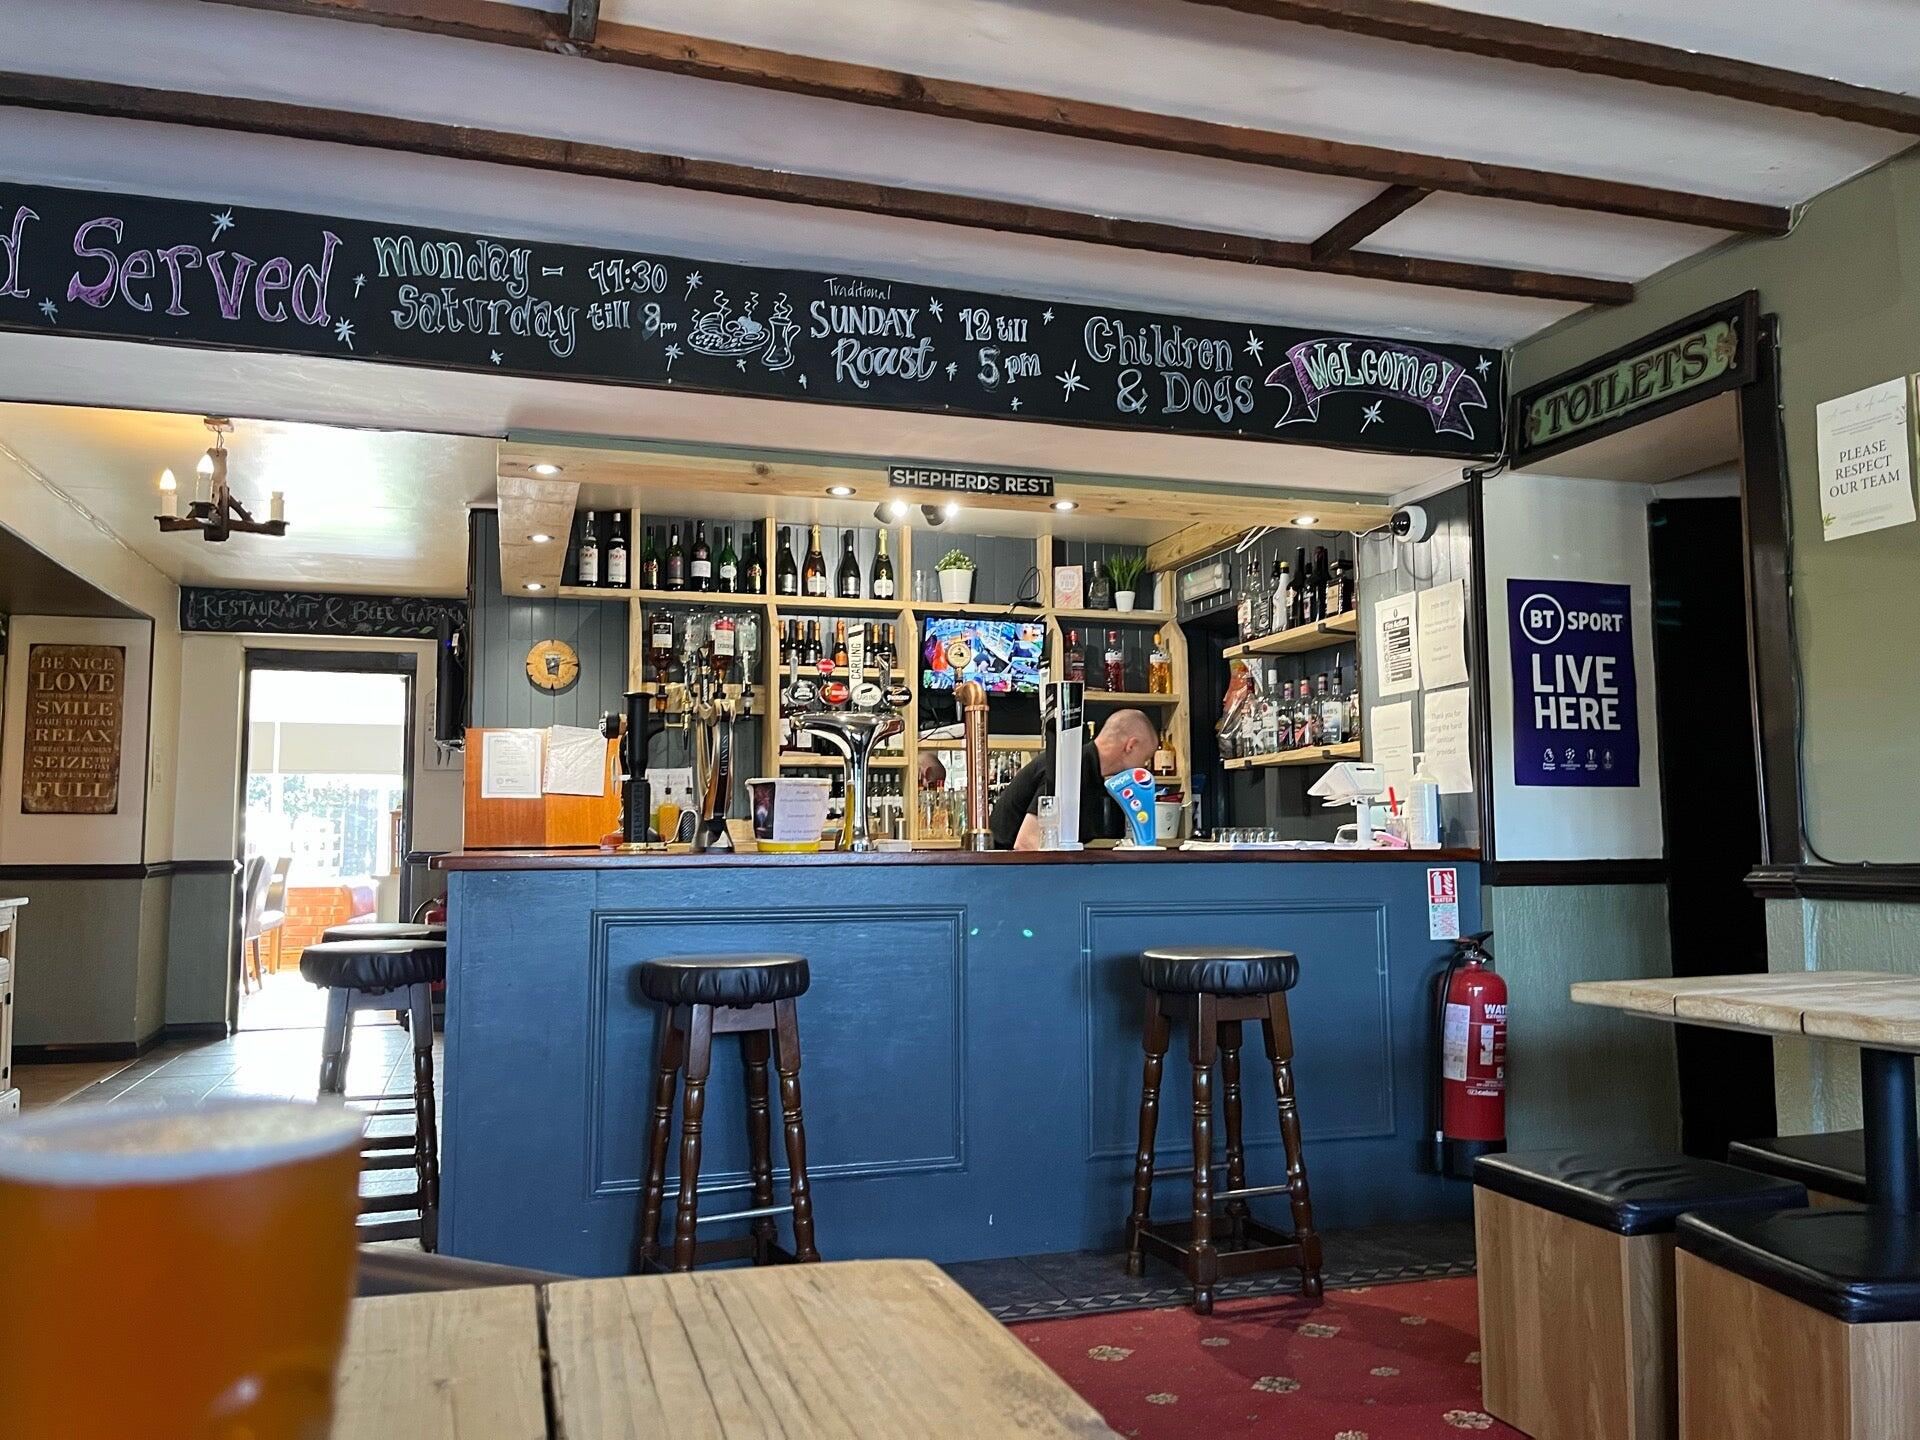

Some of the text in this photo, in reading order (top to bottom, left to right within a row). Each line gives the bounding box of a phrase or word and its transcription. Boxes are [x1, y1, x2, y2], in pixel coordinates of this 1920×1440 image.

[67, 218, 343, 327] Served
[373, 236, 532, 298] Monday
[588, 260, 668, 296] 11:30
[824, 277, 892, 300] Traditional
[391, 285, 579, 358] Saturday
[587, 301, 631, 332] till
[810, 300, 920, 339] SUNDAY
[959, 308, 1028, 343] 12 till
[1084, 316, 1234, 372] Children
[831, 337, 938, 388] Roast
[1117, 369, 1255, 424] & Dogs
[1545, 337, 1711, 434] TOILETS
[1839, 439, 1888, 464] PLEASE
[892, 469, 1051, 494] SHEPHERDS REST
[1835, 454, 1893, 481] RESPECT
[1829, 469, 1901, 499] OUR TEAM
[324, 596, 347, 628] &
[1530, 609, 1624, 632] BT SPORT
[40, 656, 115, 670] BE NICE
[850, 643, 861, 680] CARLING
[1532, 653, 1619, 695] LIVE
[37, 671, 115, 692] LOVE
[36, 701, 113, 716] SMILE
[80, 719, 114, 727] DREAM
[1534, 695, 1622, 731] HERE
[34, 728, 112, 742] RELAX
[33, 755, 93, 769] SEIZE
[719, 734, 729, 776] GUINNESS
[36, 781, 110, 798] FULL
[1109, 774, 1132, 790] pepsi
